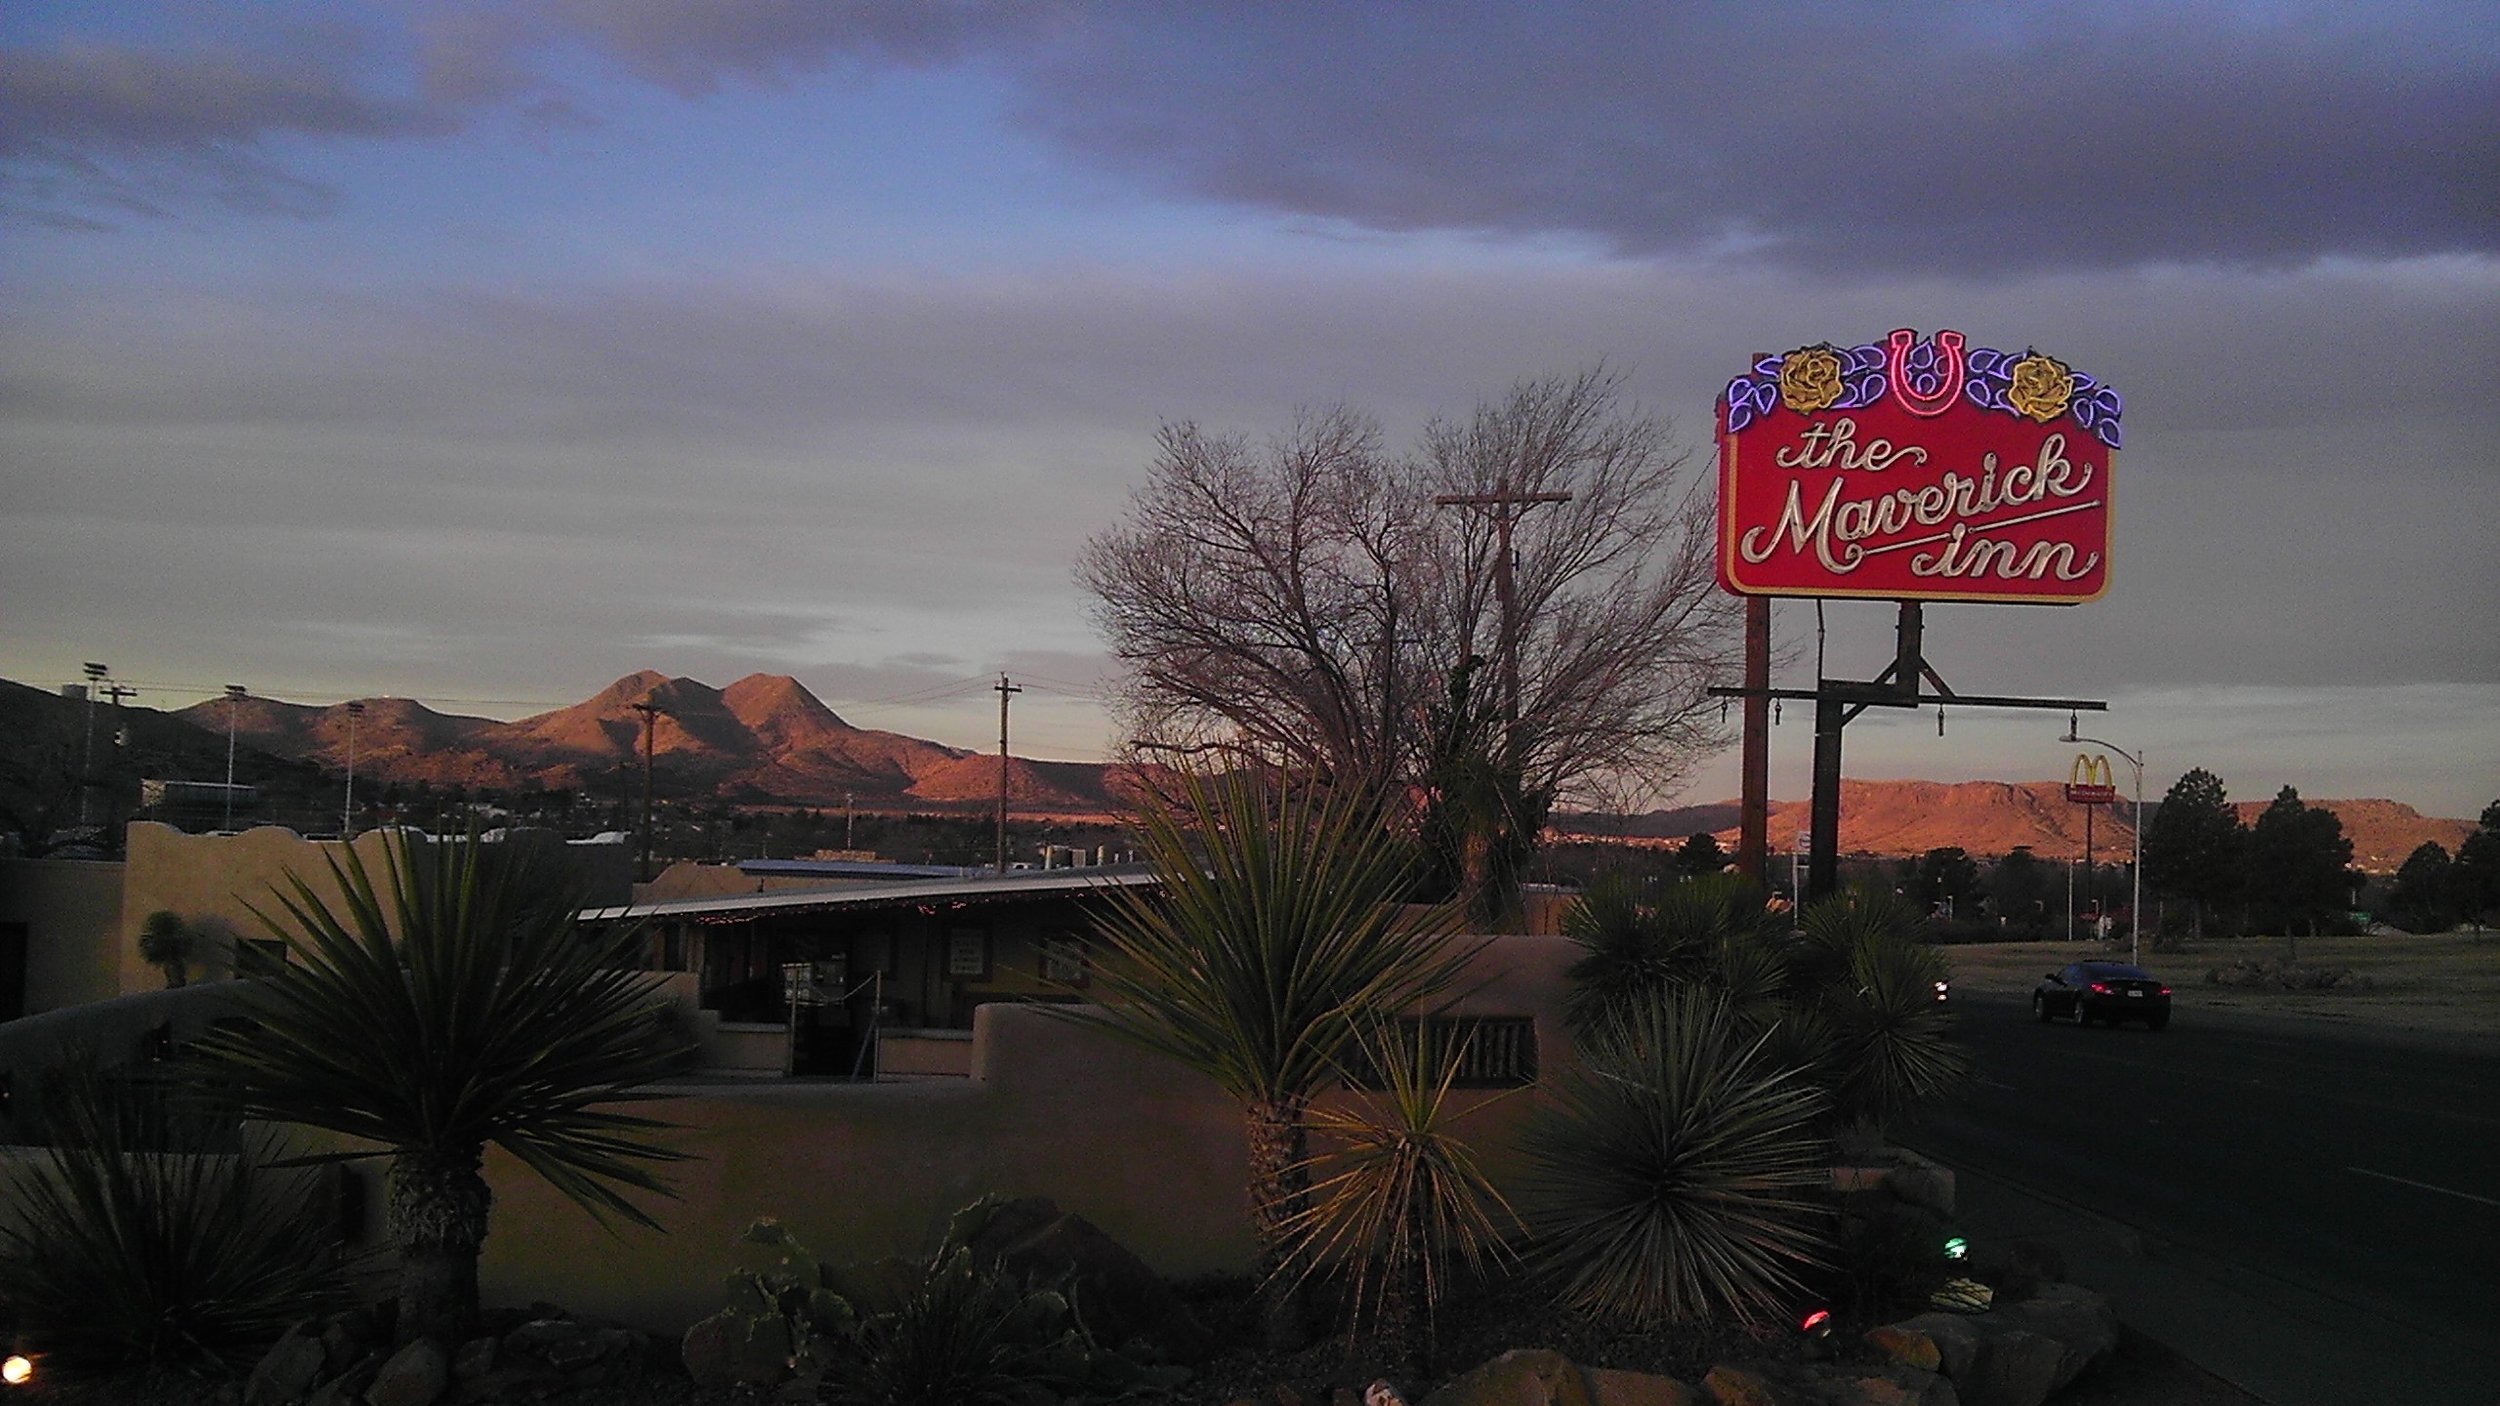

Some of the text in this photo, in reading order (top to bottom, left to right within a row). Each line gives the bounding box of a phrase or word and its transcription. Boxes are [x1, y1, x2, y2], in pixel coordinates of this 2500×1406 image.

[1776, 417, 1927, 471] the
[1741, 433, 2093, 573] Maverick
[1911, 522, 2098, 580] inn
